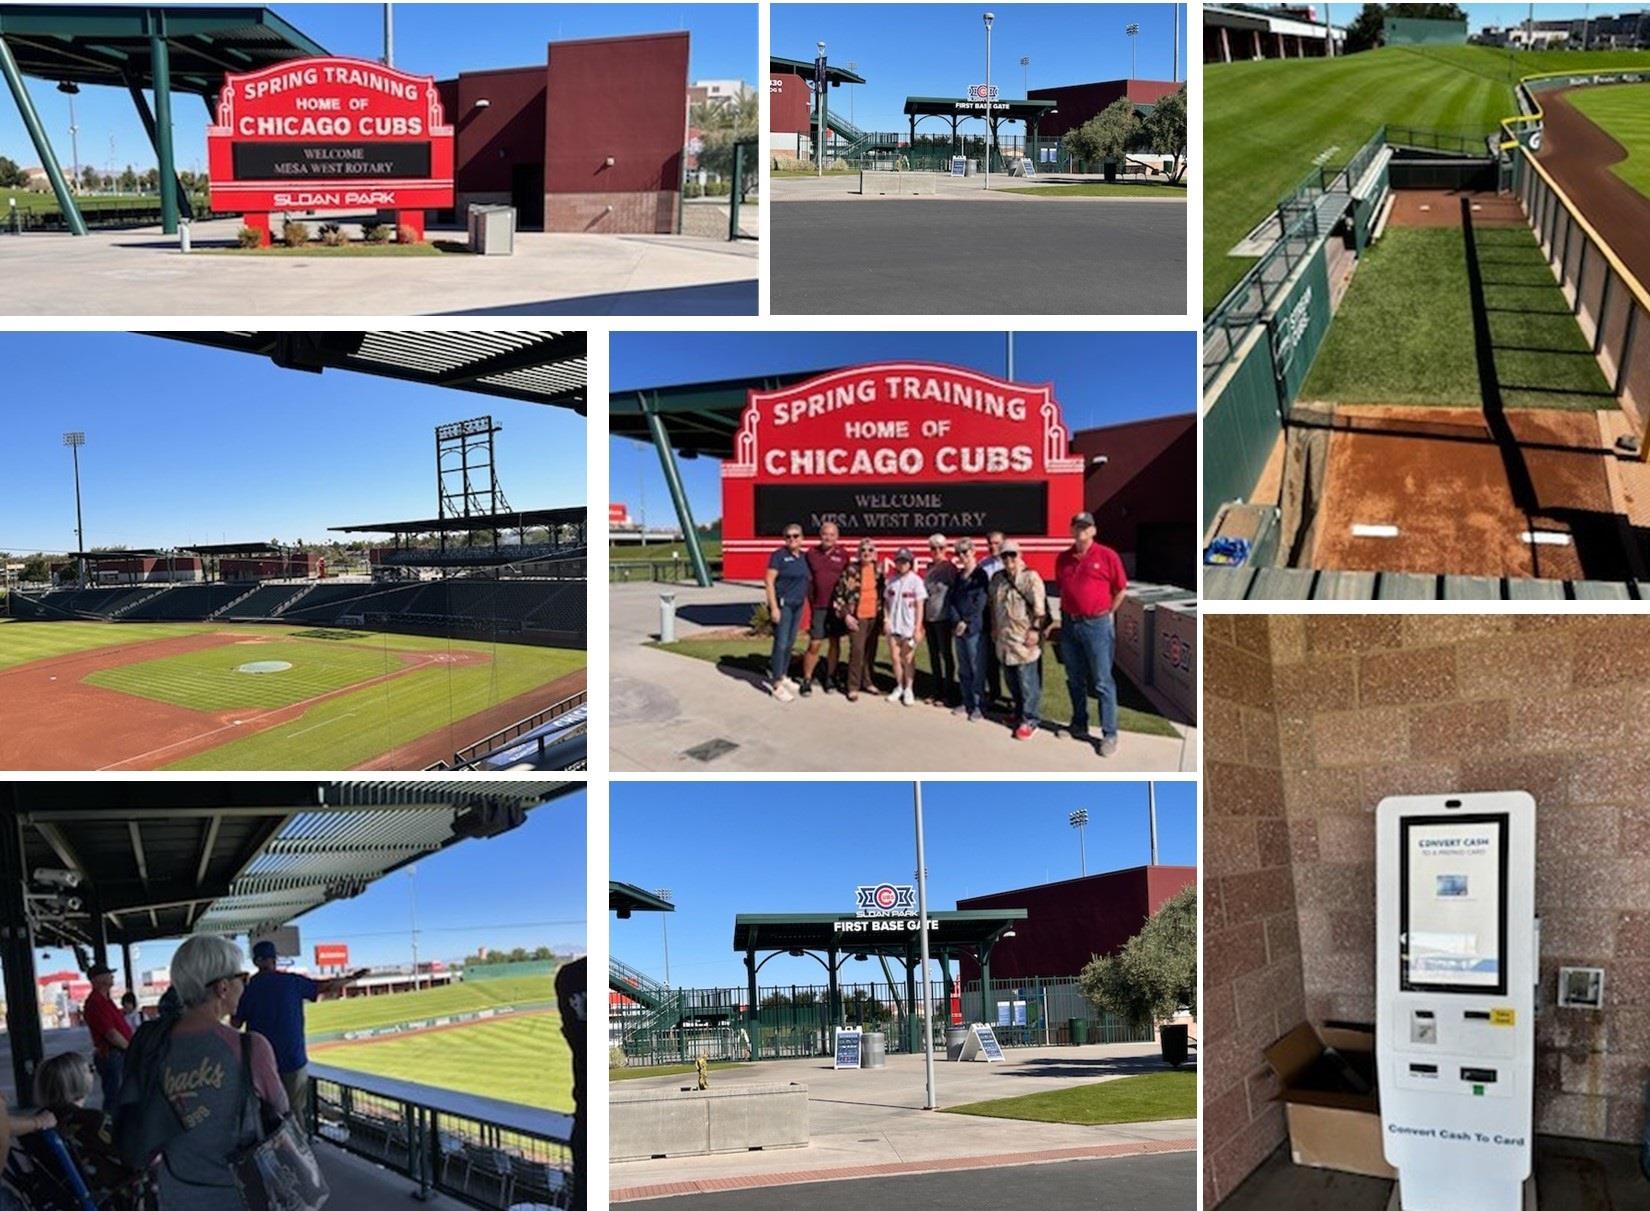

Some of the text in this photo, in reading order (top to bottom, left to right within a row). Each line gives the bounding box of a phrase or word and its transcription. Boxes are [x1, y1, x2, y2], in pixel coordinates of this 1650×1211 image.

[244, 67, 418, 100] SPRING TRAINING
[296, 98, 369, 111] HOME OF
[239, 117, 422, 136] CHICAGO CUBS
[304, 148, 364, 160] WELCOME
[273, 162, 394, 175] MESA WEST ROTARY
[273, 192, 396, 207] SLOAN PARK
[773, 376, 1026, 426] SPRING TRAINING
[845, 420, 951, 439] HOME OF
[764, 445, 1033, 475] CHICAGO CUBS
[855, 494, 942, 509] WELCOME
[811, 512, 986, 529] MESA WEST ROTARY
[1464, 838, 1489, 846] CASH
[834, 921, 869, 932] FIRST
[871, 920, 905, 931] BASE
[1388, 1124, 1525, 1146] Convert Cash To Card
